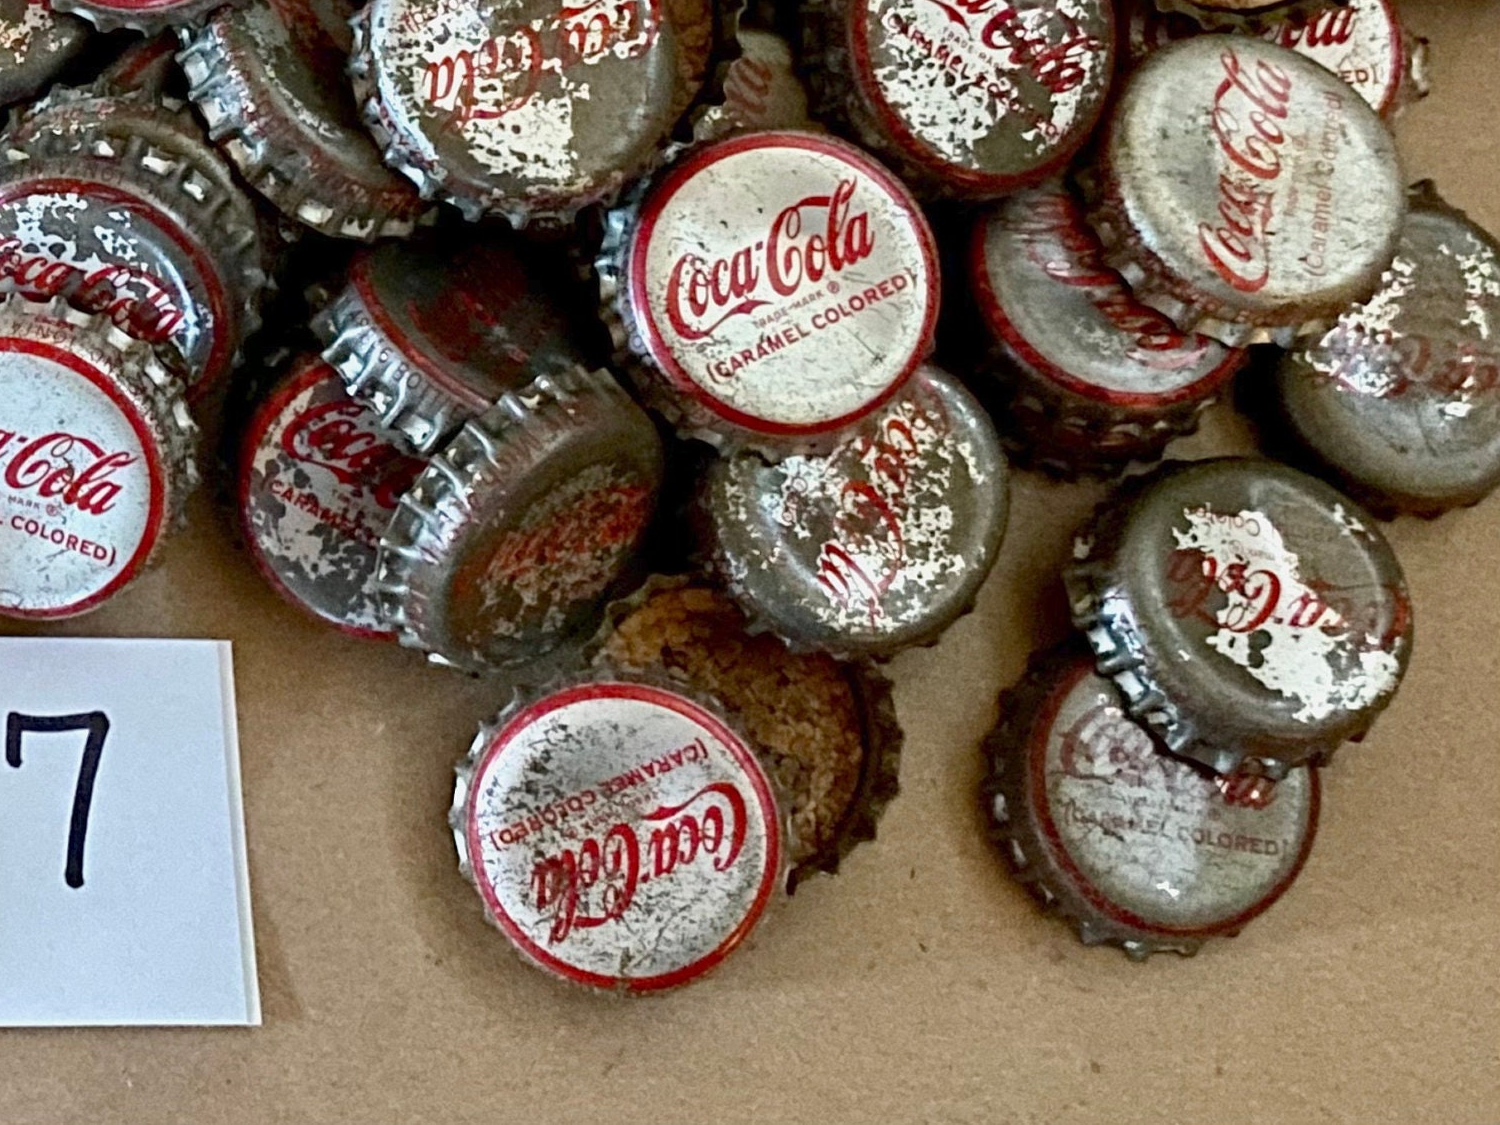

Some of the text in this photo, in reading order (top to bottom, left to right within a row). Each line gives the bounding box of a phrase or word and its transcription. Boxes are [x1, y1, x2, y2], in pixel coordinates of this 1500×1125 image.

[811, 268, 914, 329] COLORED)
[11, 515, 117, 566] COLORED)
[5, 710, 110, 889] 7
